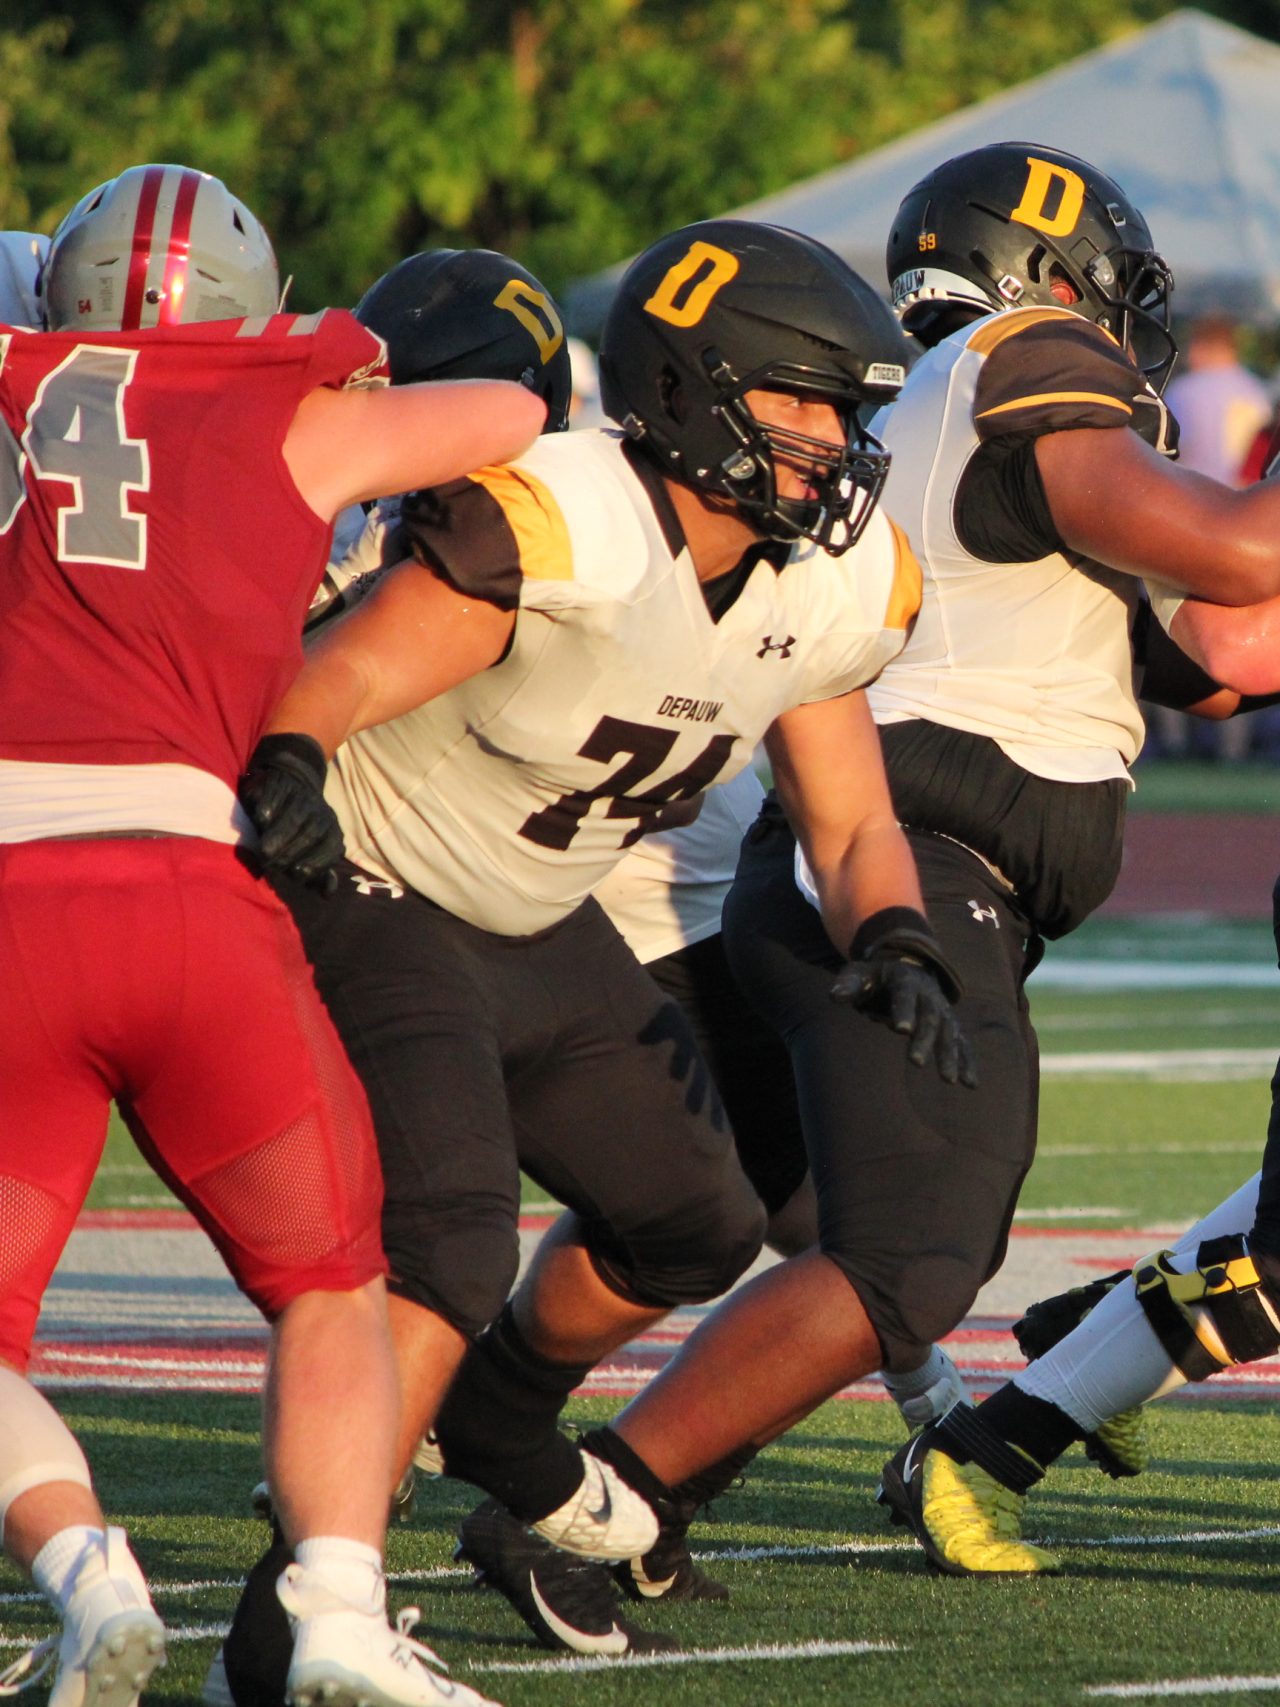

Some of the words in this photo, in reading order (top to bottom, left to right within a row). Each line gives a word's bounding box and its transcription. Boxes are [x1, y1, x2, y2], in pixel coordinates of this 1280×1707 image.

[1010, 157, 1085, 237] D
[918, 232, 936, 252] 59
[78, 299, 92, 314] 54
[493, 279, 564, 366] D
[643, 240, 739, 328] D
[0, 334, 151, 571] 4
[657, 694, 724, 723] DEPAUW
